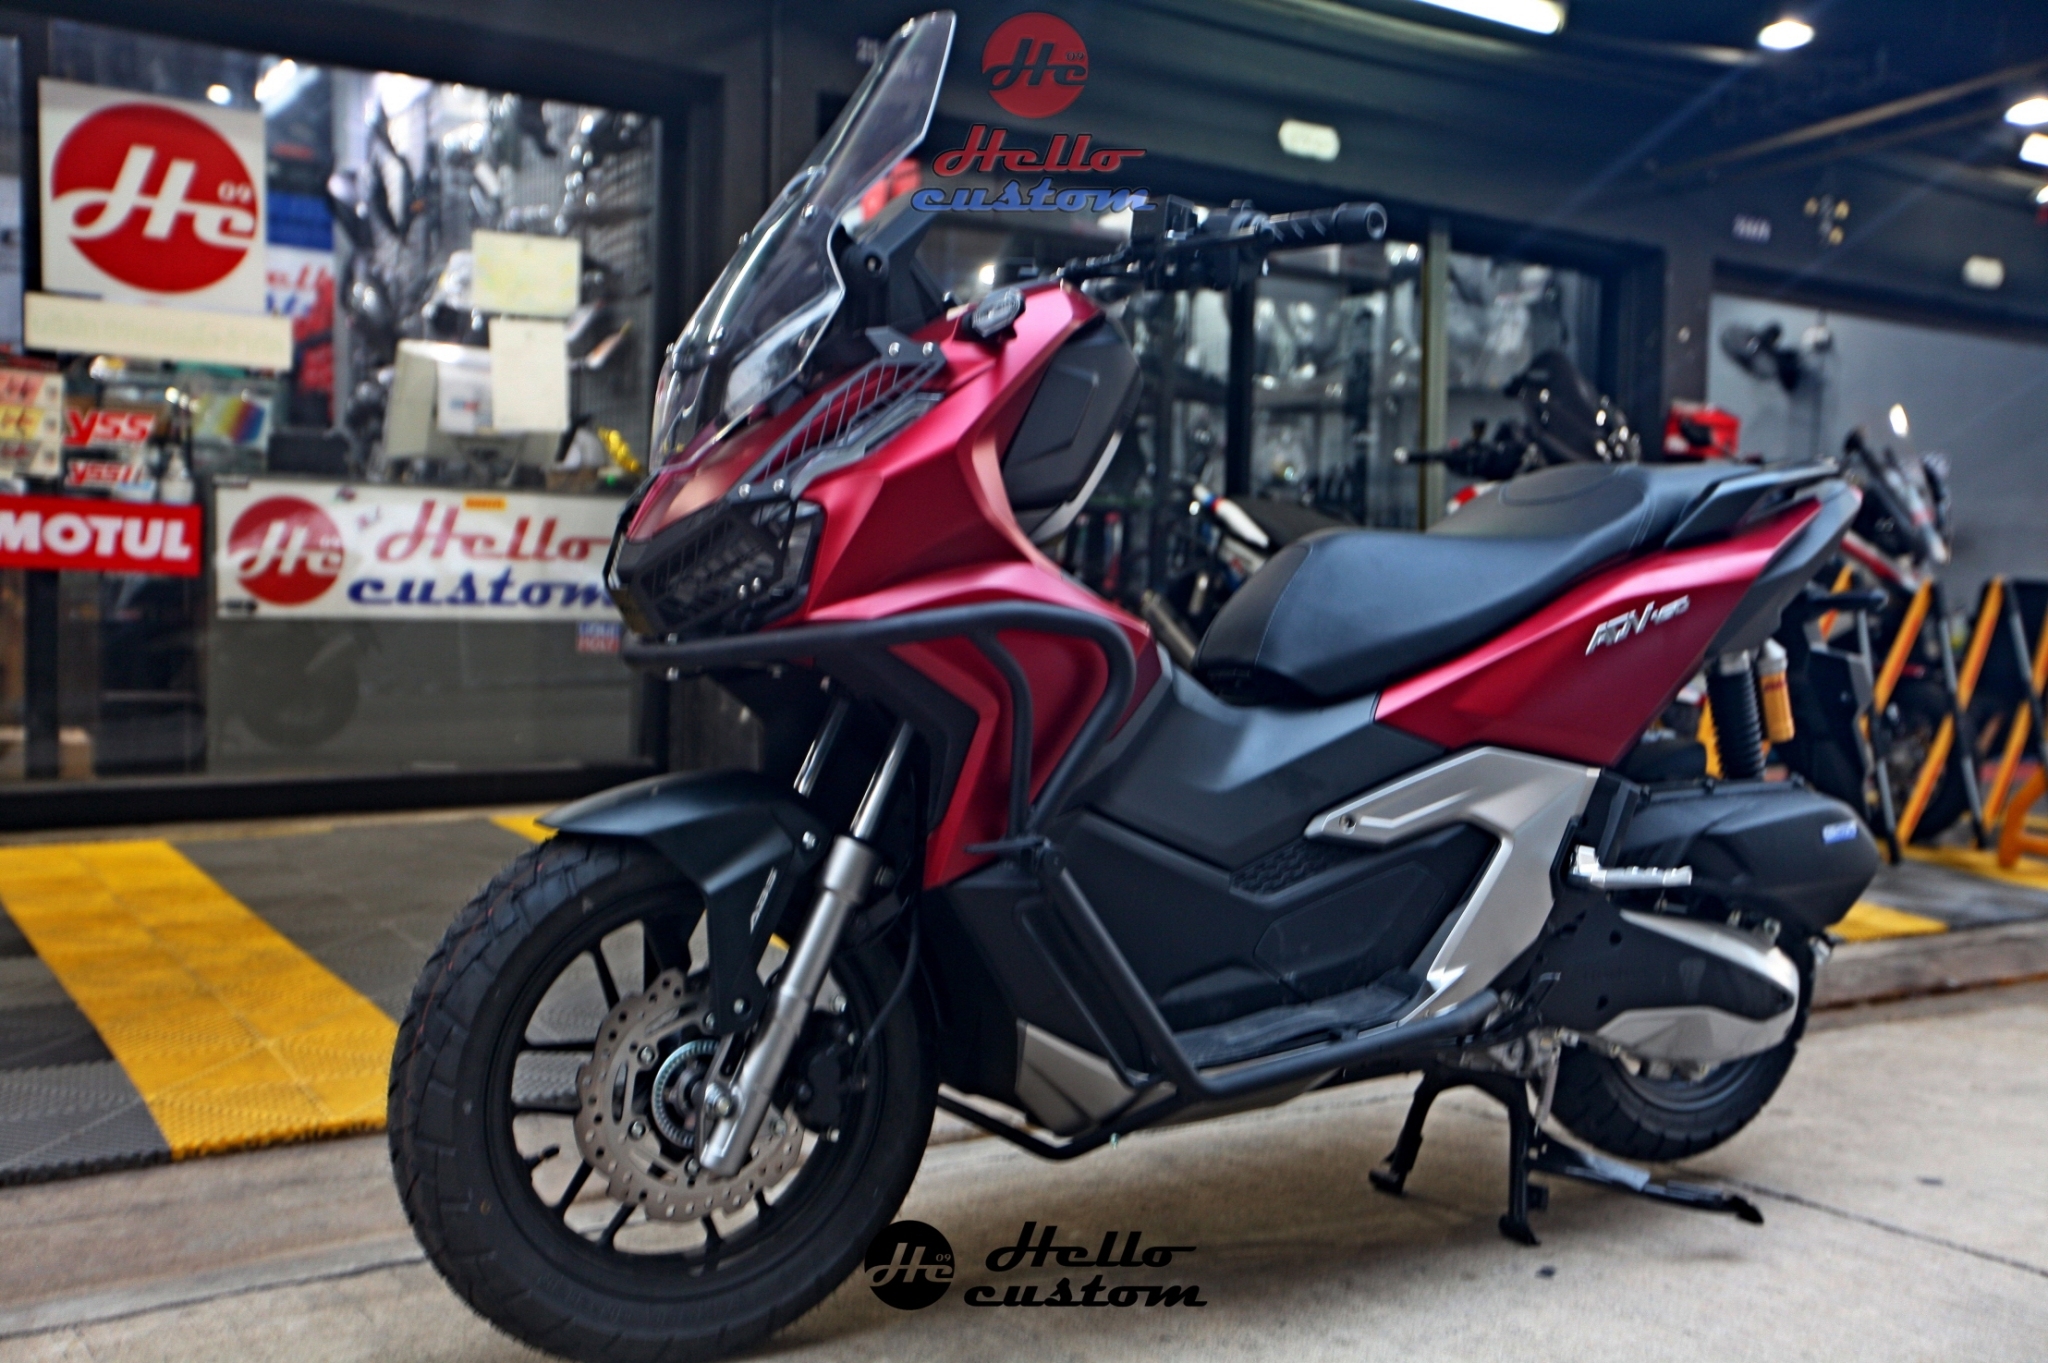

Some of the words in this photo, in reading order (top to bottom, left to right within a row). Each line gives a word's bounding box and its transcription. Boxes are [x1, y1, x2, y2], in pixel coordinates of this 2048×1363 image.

[217, 179, 252, 203] 09
[0, 511, 191, 560] MOTUL
[376, 498, 612, 563] Hello
